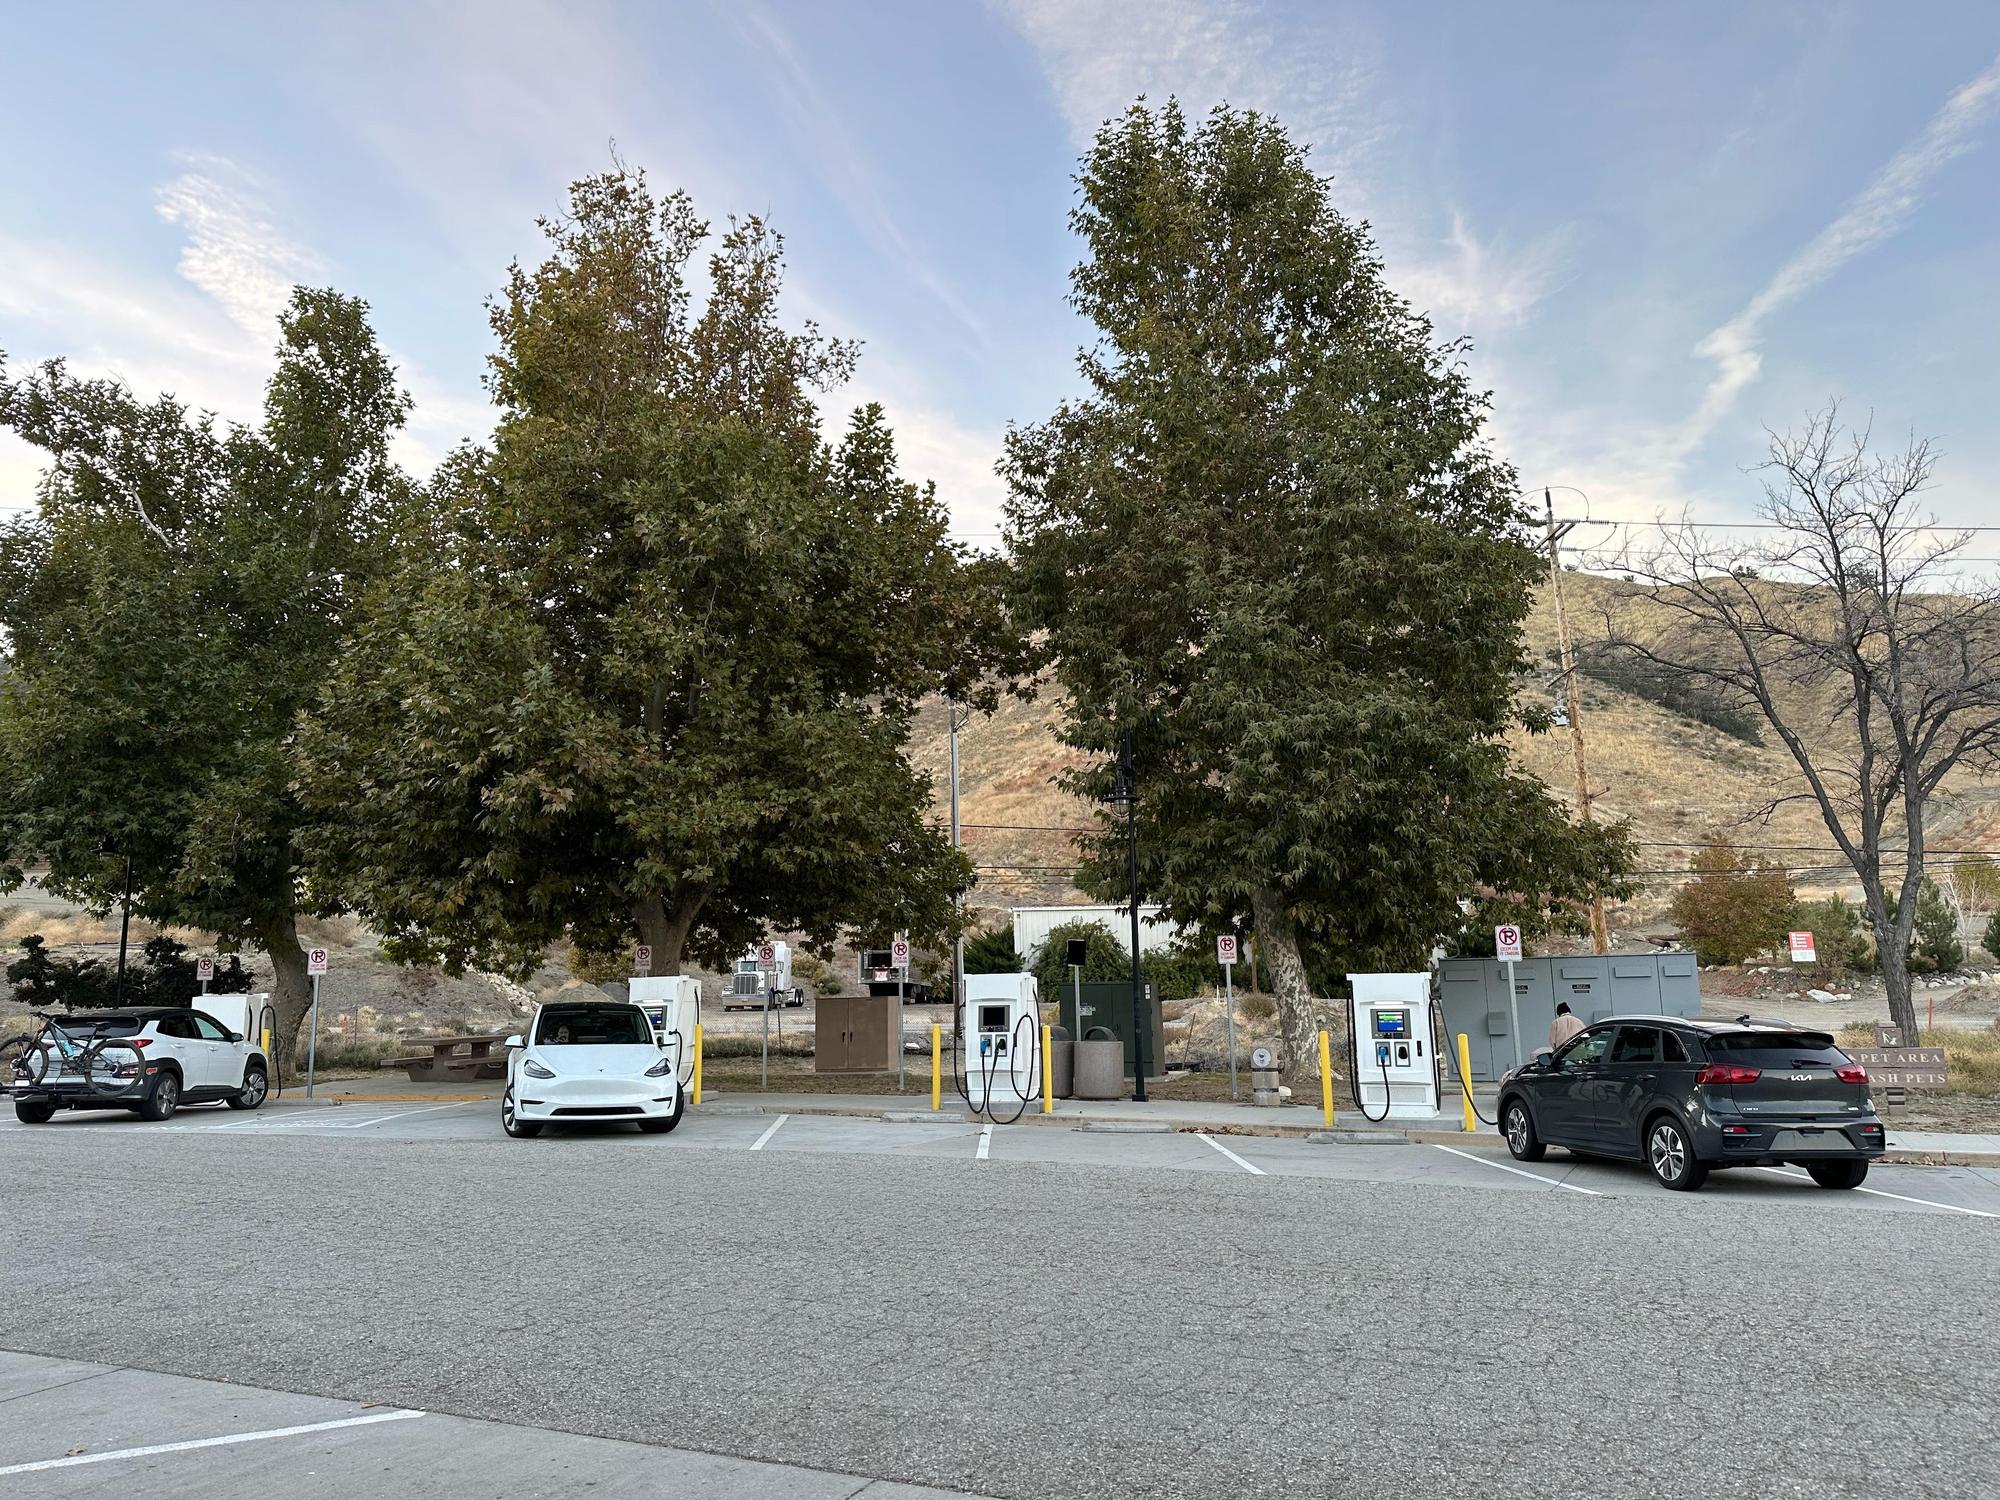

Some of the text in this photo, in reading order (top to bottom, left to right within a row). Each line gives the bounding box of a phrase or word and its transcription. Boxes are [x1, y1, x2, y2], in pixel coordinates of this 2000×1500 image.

[1860, 1053, 1941, 1063] PET AREA
[1869, 1073, 1946, 1083] ASH PETS
